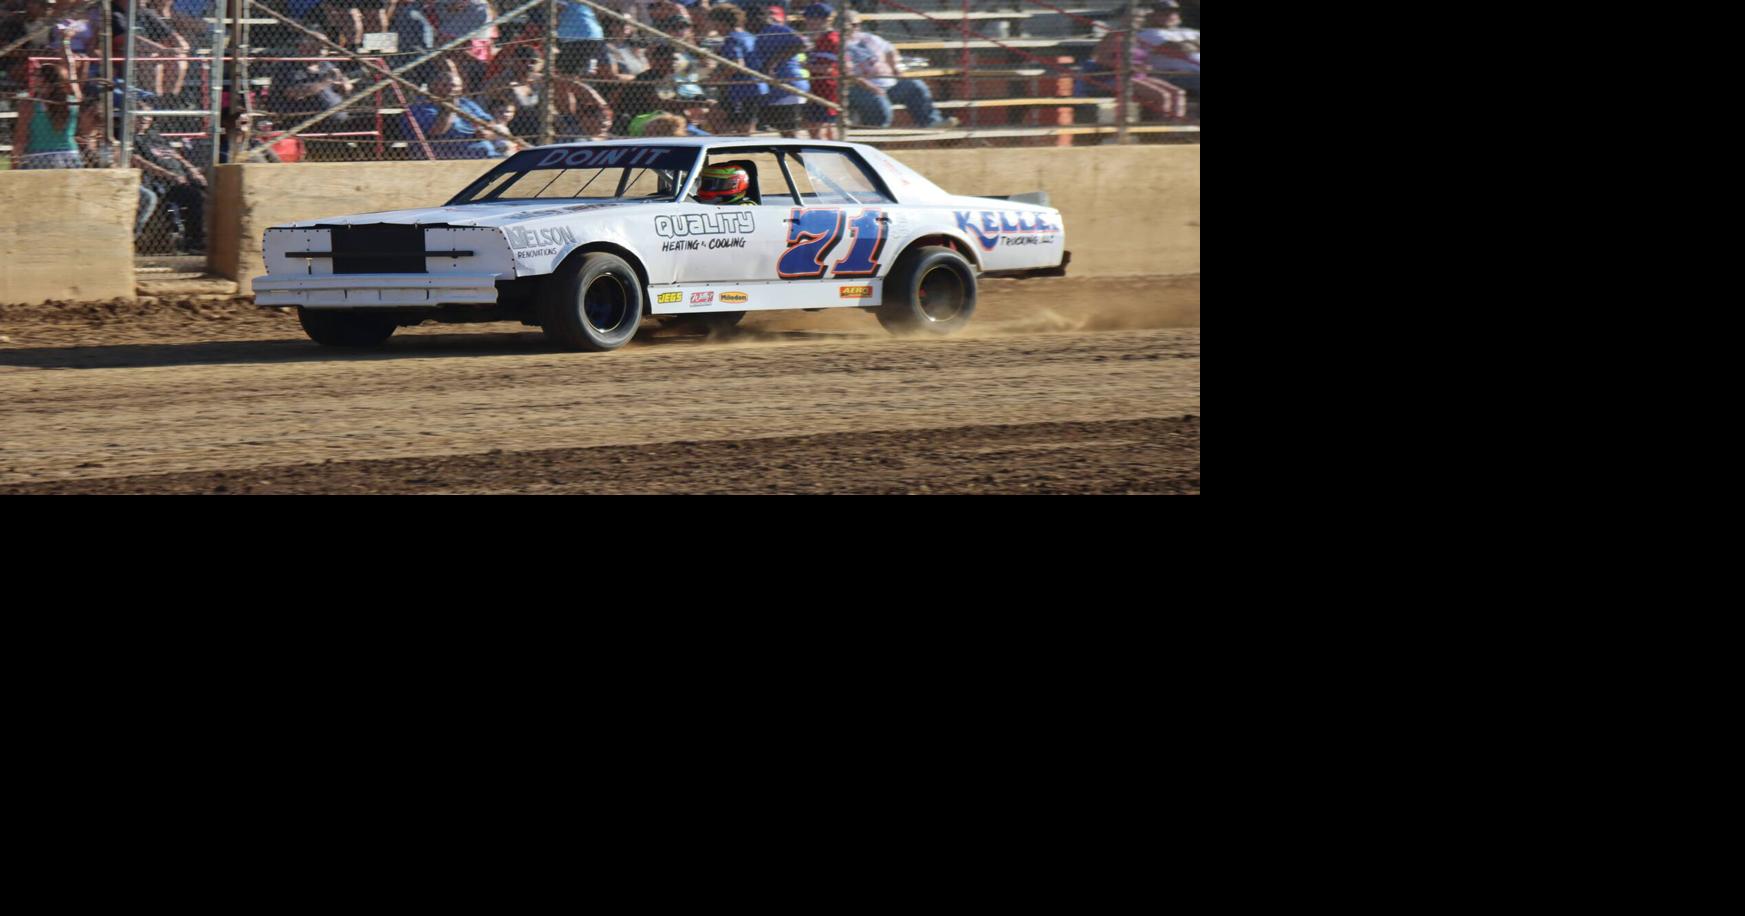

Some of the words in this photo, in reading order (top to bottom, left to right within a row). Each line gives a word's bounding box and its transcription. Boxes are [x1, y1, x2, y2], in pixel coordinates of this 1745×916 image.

[504, 225, 577, 249] NELSON
[662, 240, 700, 251] HEATING
[708, 237, 746, 249] COOLING
[776, 207, 889, 280] 71
[517, 247, 558, 258] RENOVATIONS
[657, 291, 683, 303] JEGS
